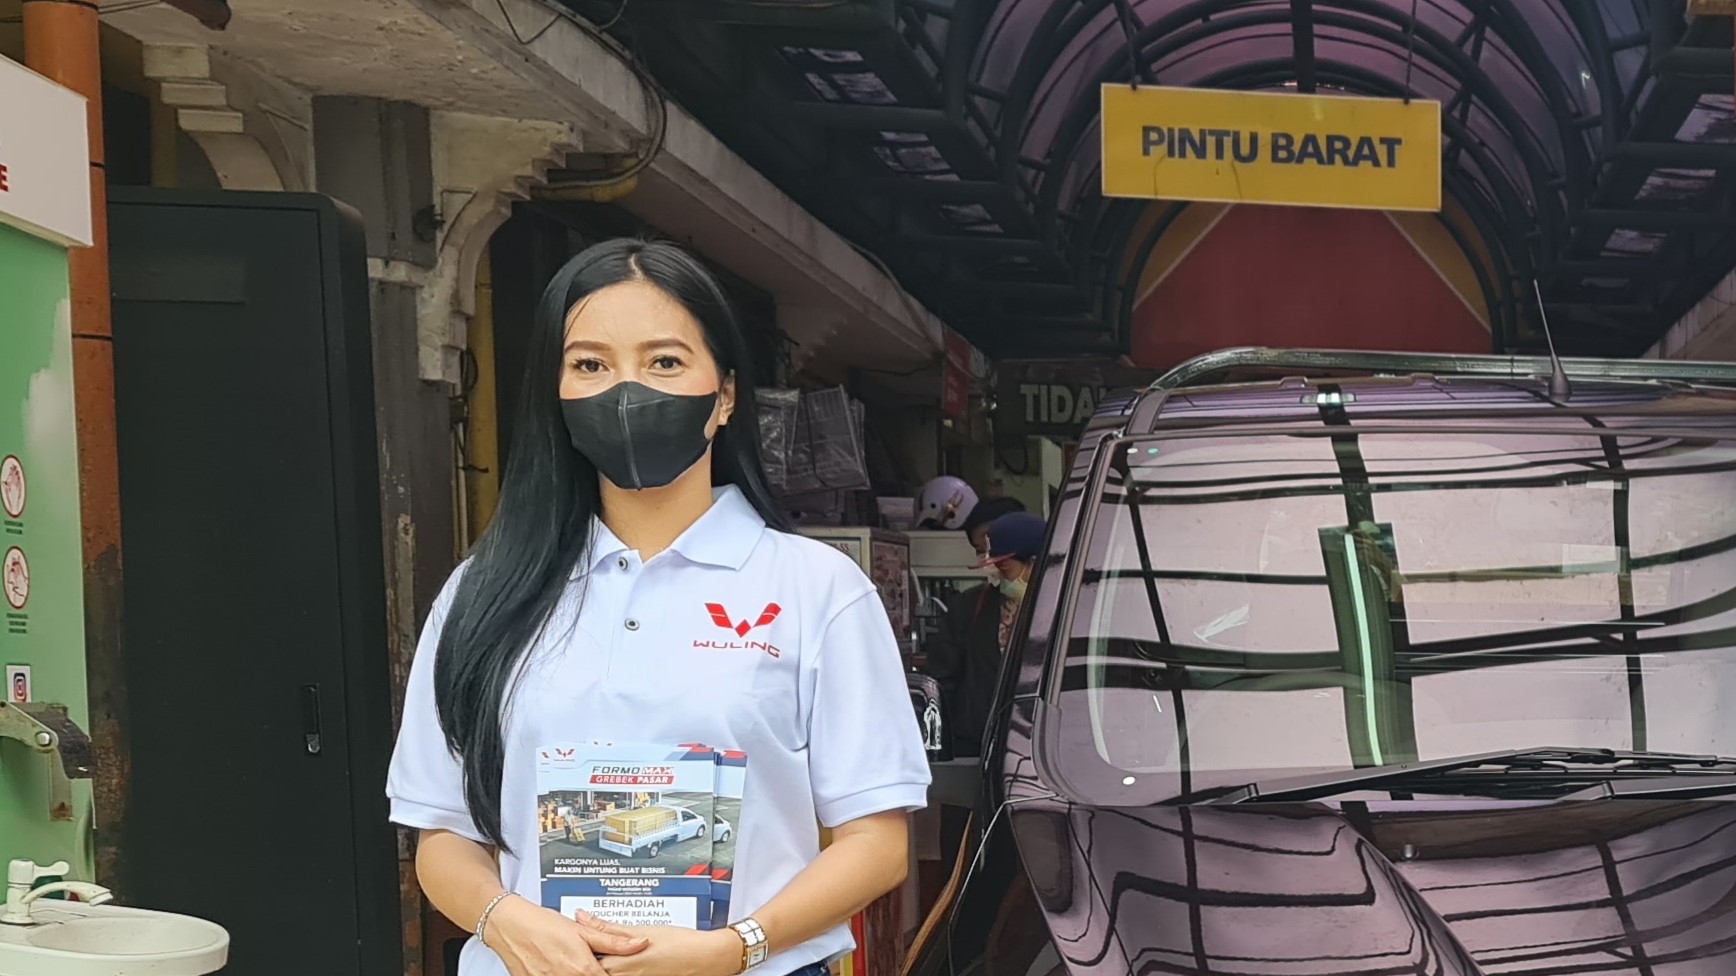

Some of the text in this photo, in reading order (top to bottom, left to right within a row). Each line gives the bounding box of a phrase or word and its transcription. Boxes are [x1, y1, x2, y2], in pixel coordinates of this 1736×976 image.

[1142, 125, 1402, 168] PINTU BARAT
[693, 640, 780, 659] WULING
[592, 766, 640, 775] FORMO
[595, 775, 669, 784] GREBEK PASAR
[599, 878, 660, 887] TANGERANG
[593, 899, 665, 908] BERHADIAH
